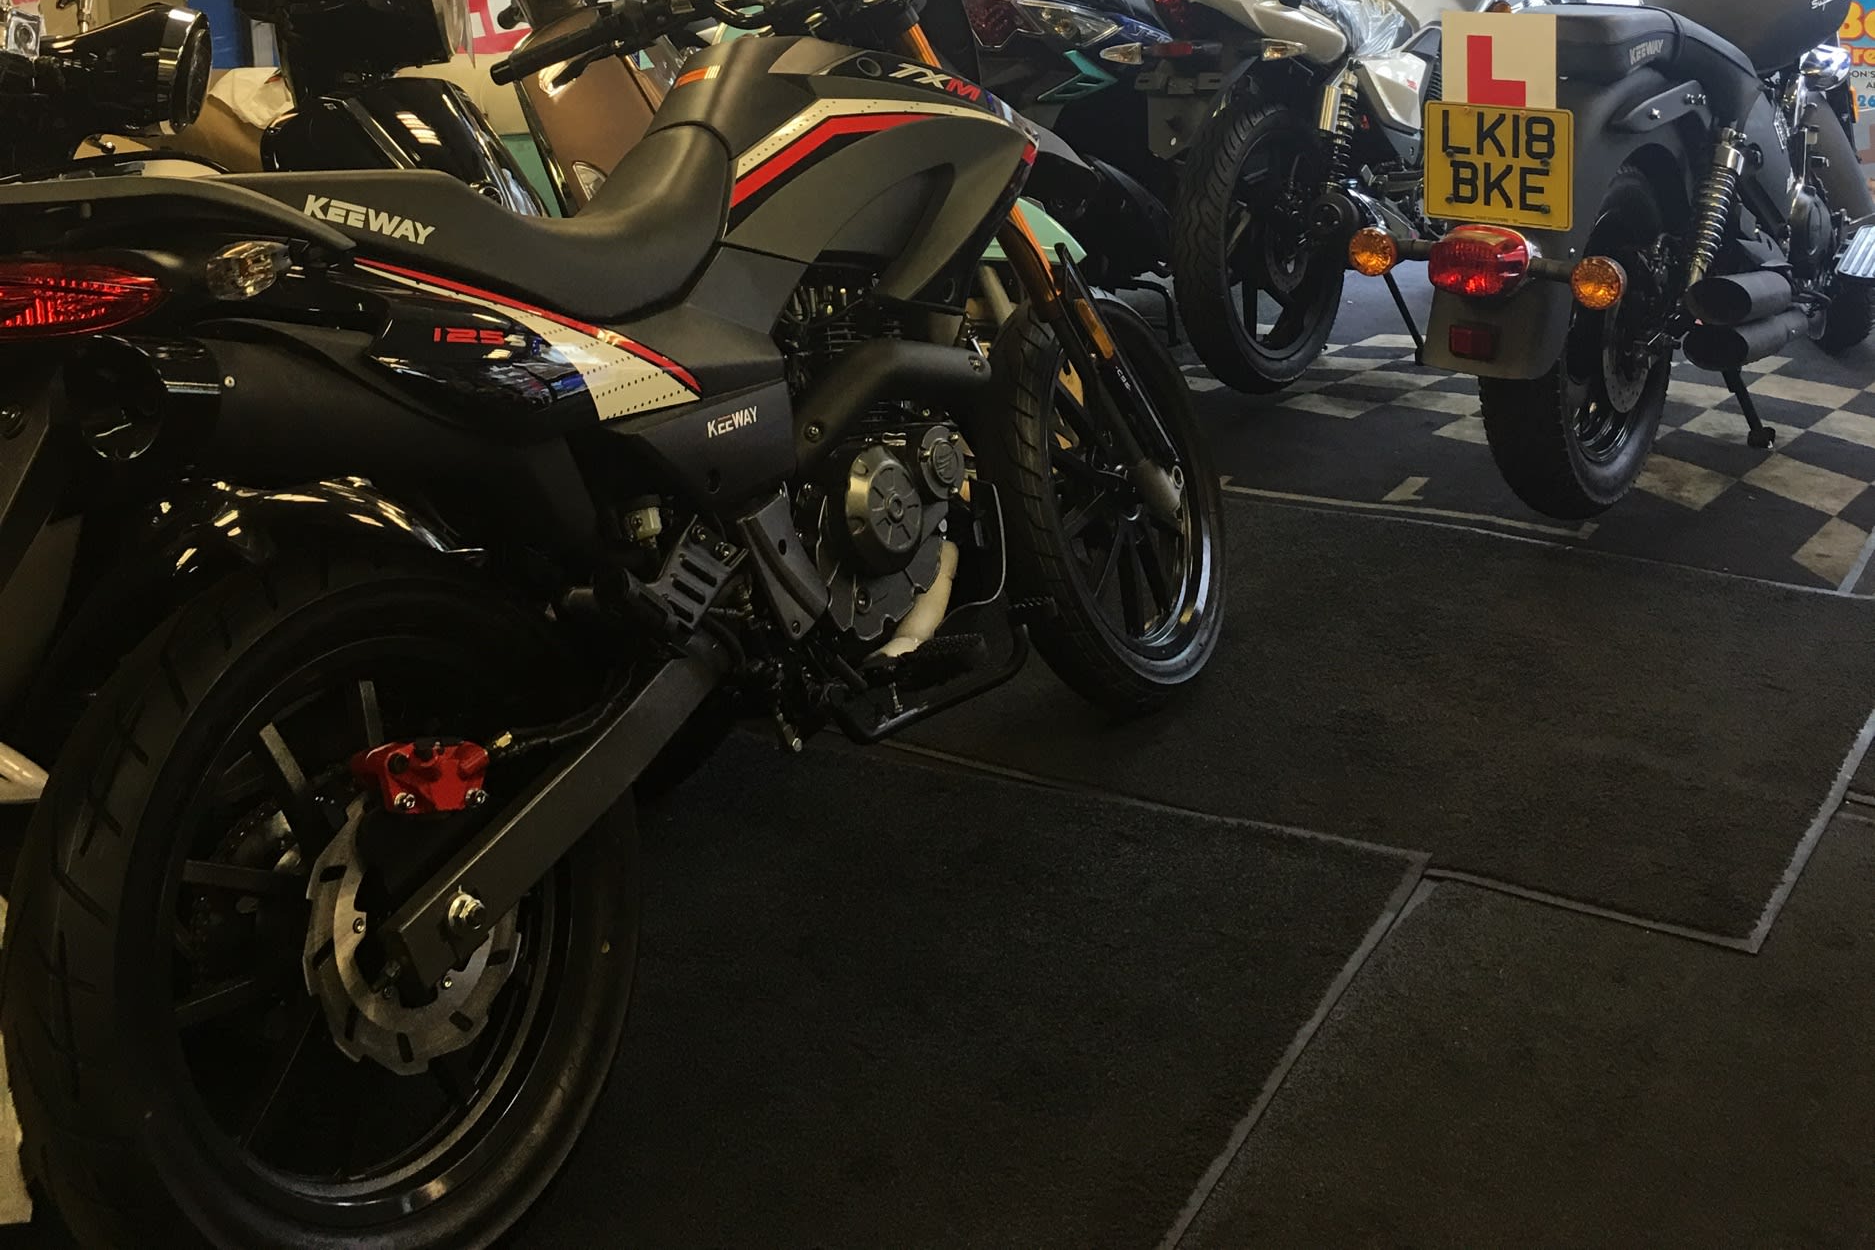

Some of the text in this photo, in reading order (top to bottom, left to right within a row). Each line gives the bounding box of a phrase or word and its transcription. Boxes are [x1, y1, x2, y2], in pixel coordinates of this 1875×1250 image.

[1467, 35, 1526, 107] L
[1629, 39, 1664, 65] KEEWAY
[888, 62, 982, 102] TXM
[1442, 109, 1556, 160] LK18
[1449, 160, 1550, 212] BKE
[303, 194, 437, 246] KEEWAY
[707, 405, 758, 439] KEEWAY
